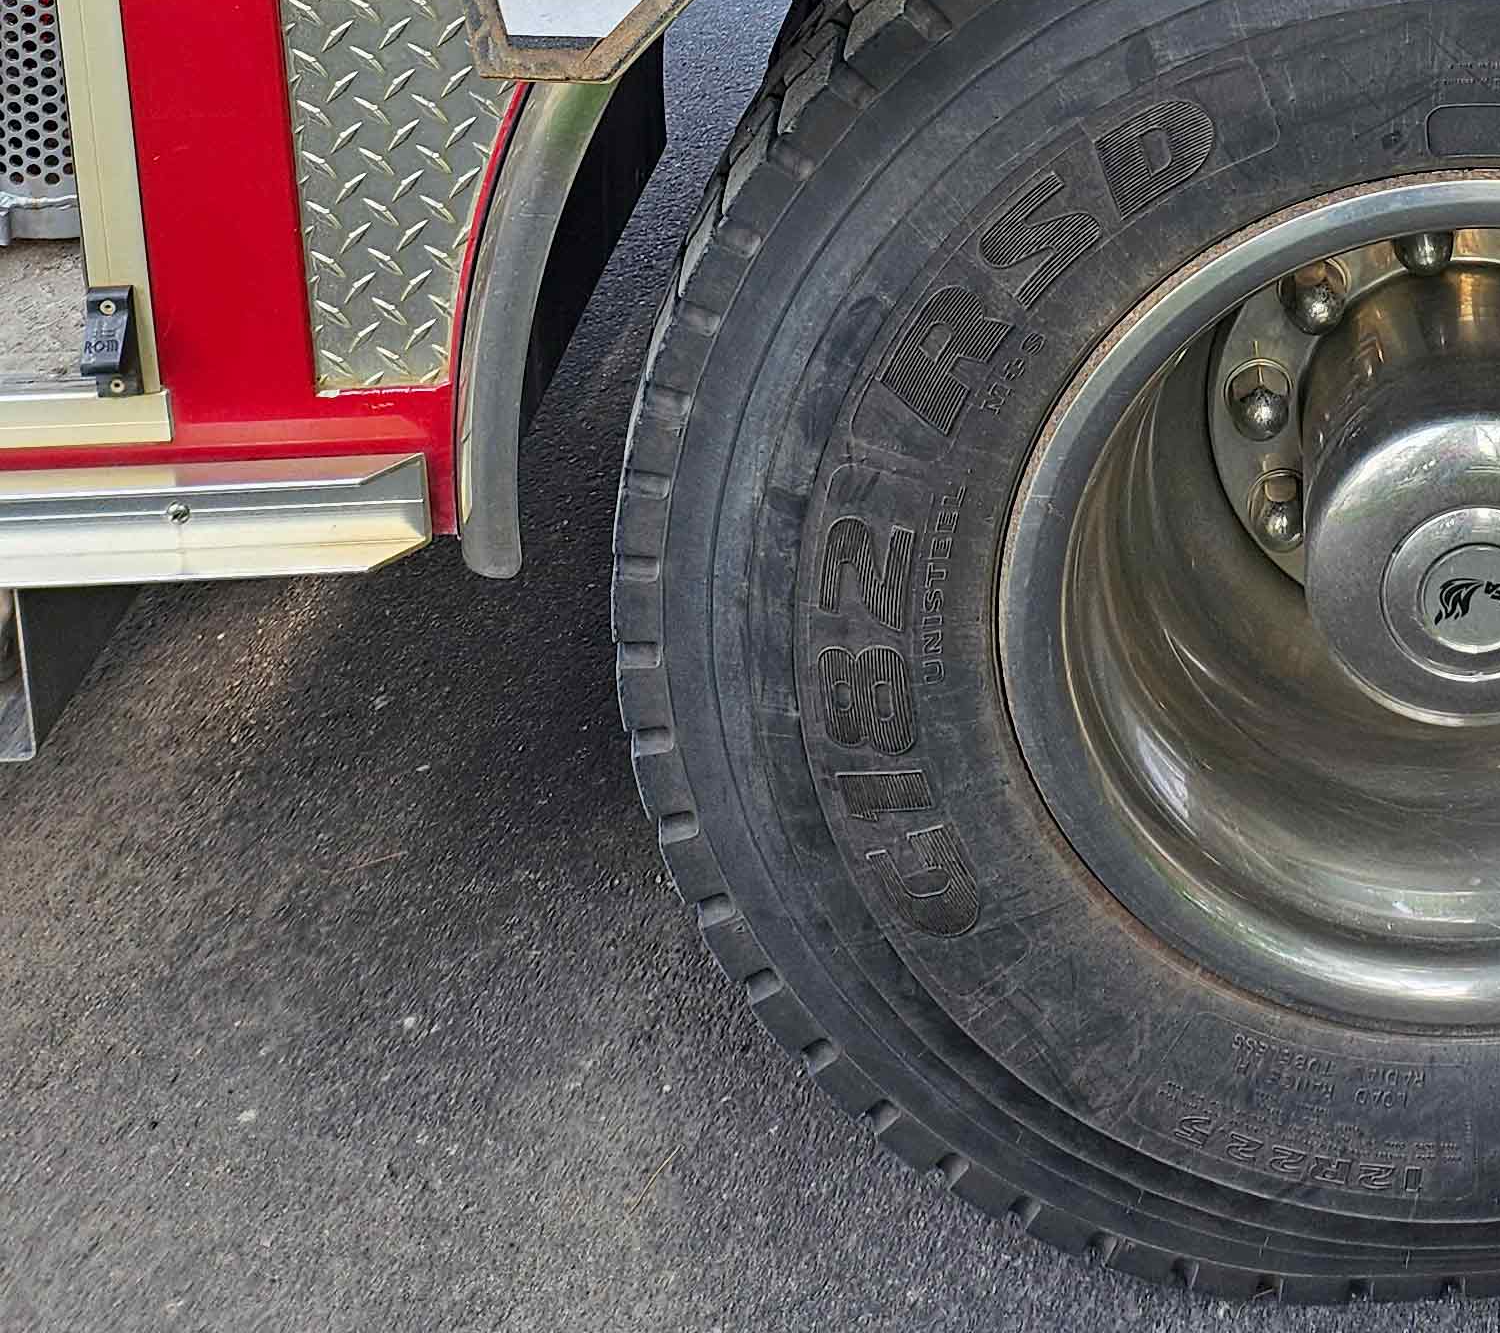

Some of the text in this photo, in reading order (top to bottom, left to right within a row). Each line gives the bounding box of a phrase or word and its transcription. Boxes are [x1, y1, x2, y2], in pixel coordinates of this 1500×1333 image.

[921, 485, 968, 685] UNISTEEL
[817, 514, 981, 938] G182
[1354, 1088, 1409, 1110] LOAD
